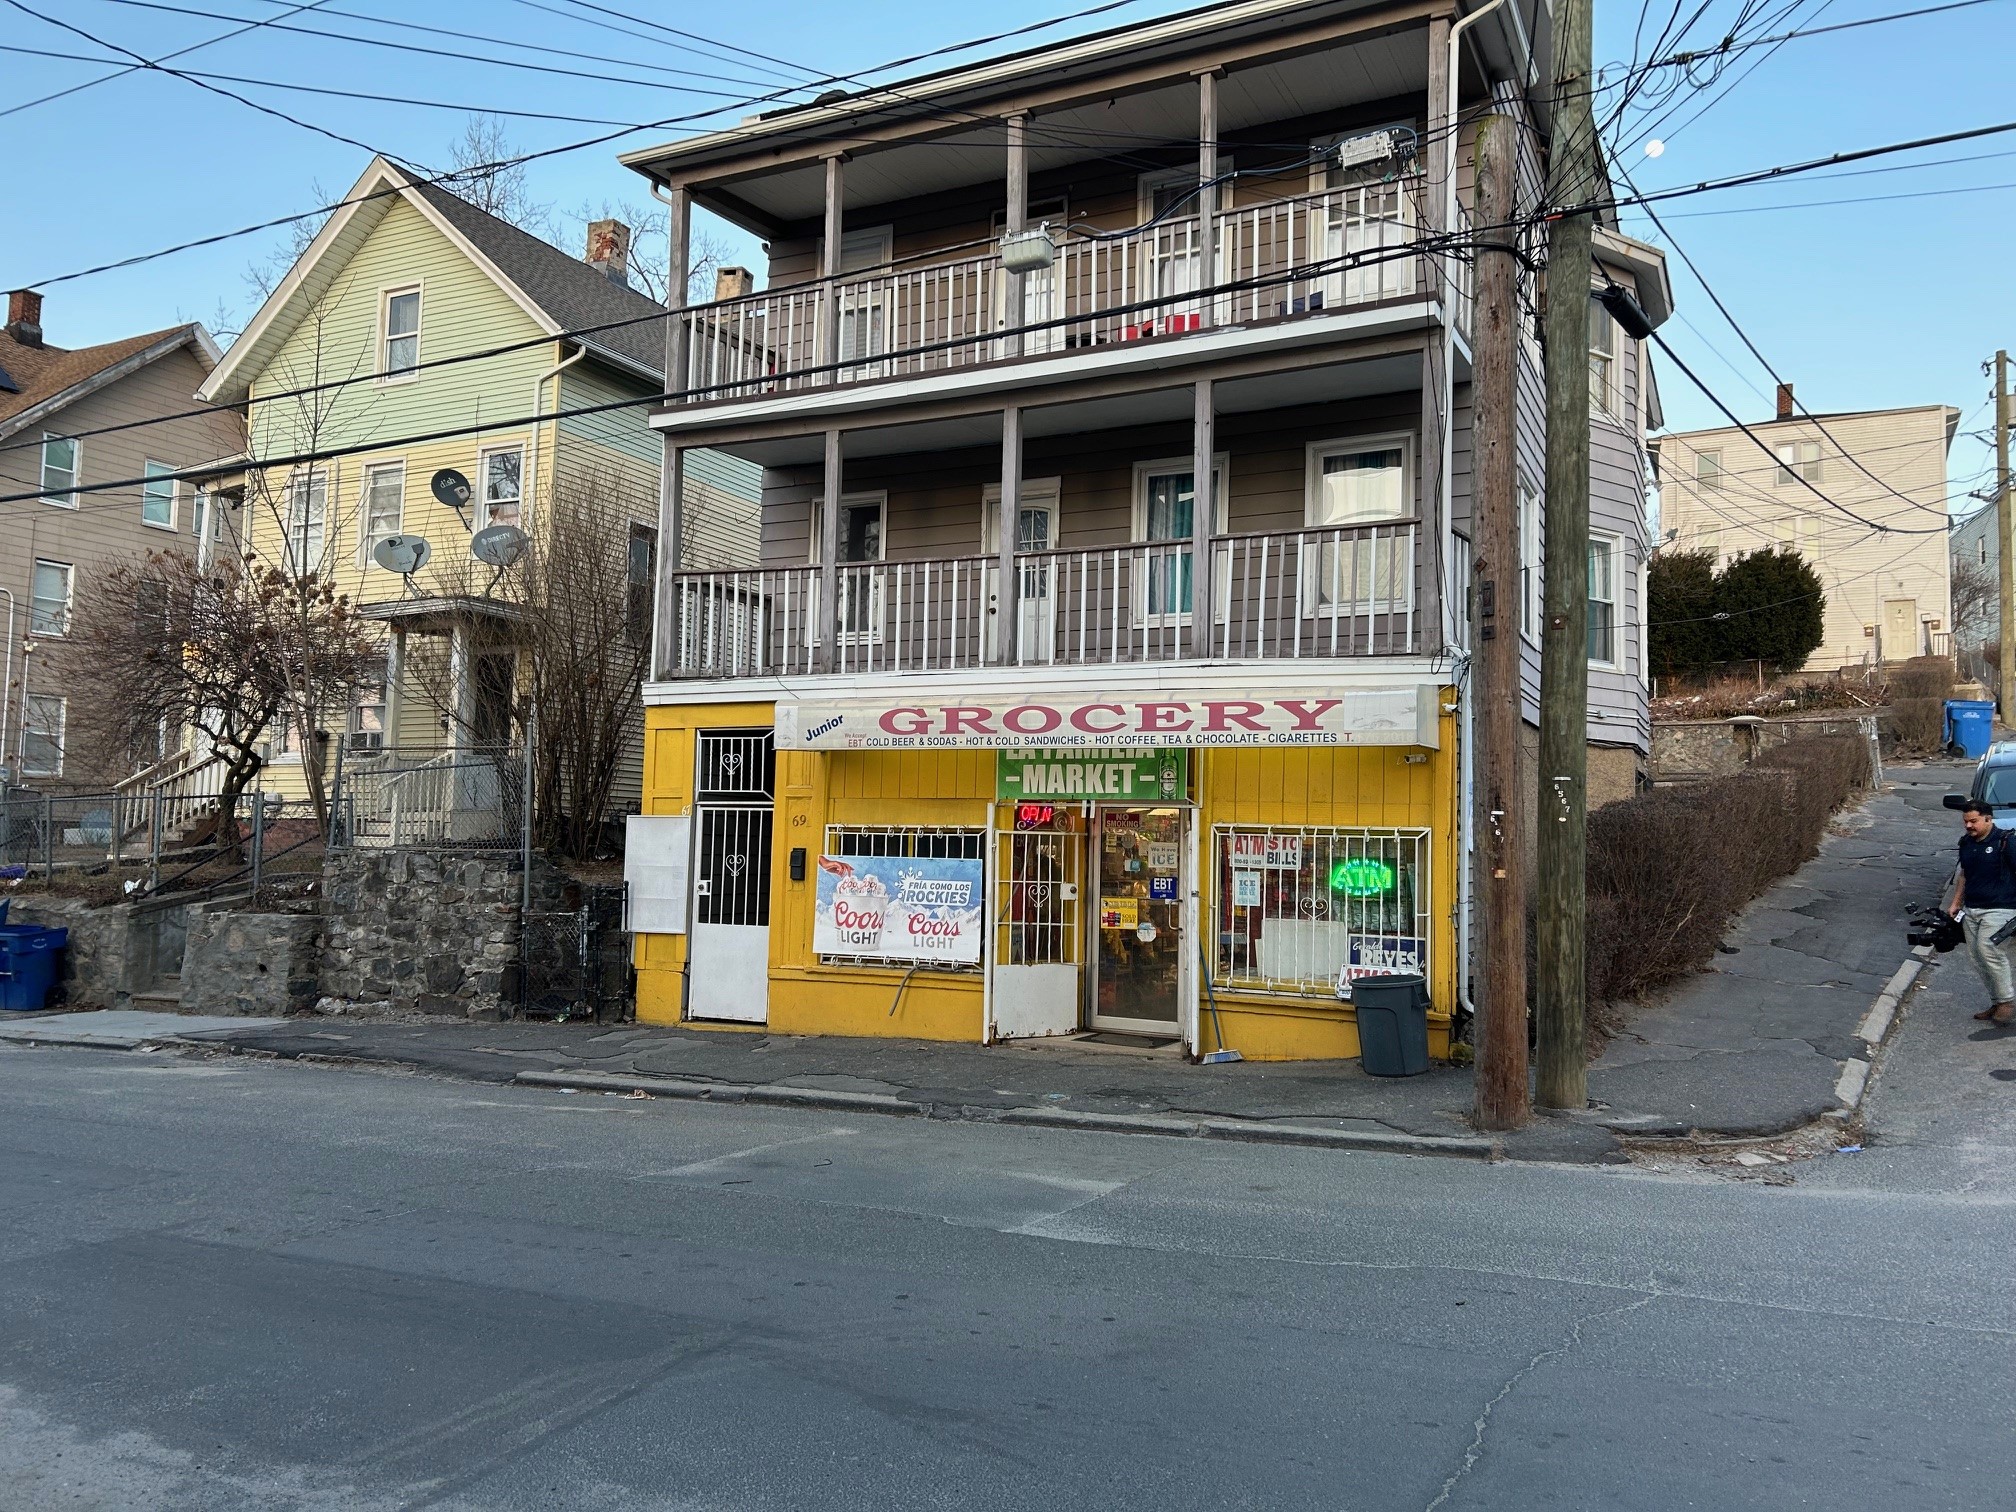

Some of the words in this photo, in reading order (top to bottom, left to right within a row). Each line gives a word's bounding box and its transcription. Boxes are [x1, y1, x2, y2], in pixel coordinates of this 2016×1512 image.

[440, 477, 456, 488] dish
[878, 699, 1343, 736] GROCERY
[805, 714, 843, 741] Junior
[848, 739, 863, 748] EBT
[866, 737, 889, 747] COLD
[892, 737, 915, 746] BEER
[918, 737, 925, 746] &
[927, 736, 957, 746] SODAS
[965, 736, 984, 746] HOT
[986, 736, 993, 745] &
[995, 736, 1020, 746] COLD
[1024, 735, 1086, 745] SANDWICHES
[1095, 735, 1115, 745] HOT
[1117, 735, 1159, 746] COFFEE,
[1163, 734, 1182, 744] TEA
[1185, 734, 1193, 744] &
[1195, 733, 1259, 744] CHOCOLATE
[1267, 732, 1337, 743] CIGARETTES
[792, 814, 807, 827] 69
[1106, 820, 1139, 828] SMOKING
[1115, 813, 1130, 821] NO
[1234, 836, 1265, 855] ATM
[1152, 853, 1175, 865] ICE
[1153, 877, 1173, 890] EBT
[1238, 879, 1256, 887] ICE
[1331, 866, 1392, 889] ATM
[908, 881, 927, 890] FRÍA
[929, 882, 953, 891] COMO
[954, 883, 970, 892] LOS
[905, 889, 968, 904] ROCKIES
[834, 900, 886, 930] Coors
[908, 912, 962, 937] Coors
[840, 930, 879, 945] LIGHT
[913, 935, 955, 949] LIGHT
[1360, 950, 1417, 969] REYES
